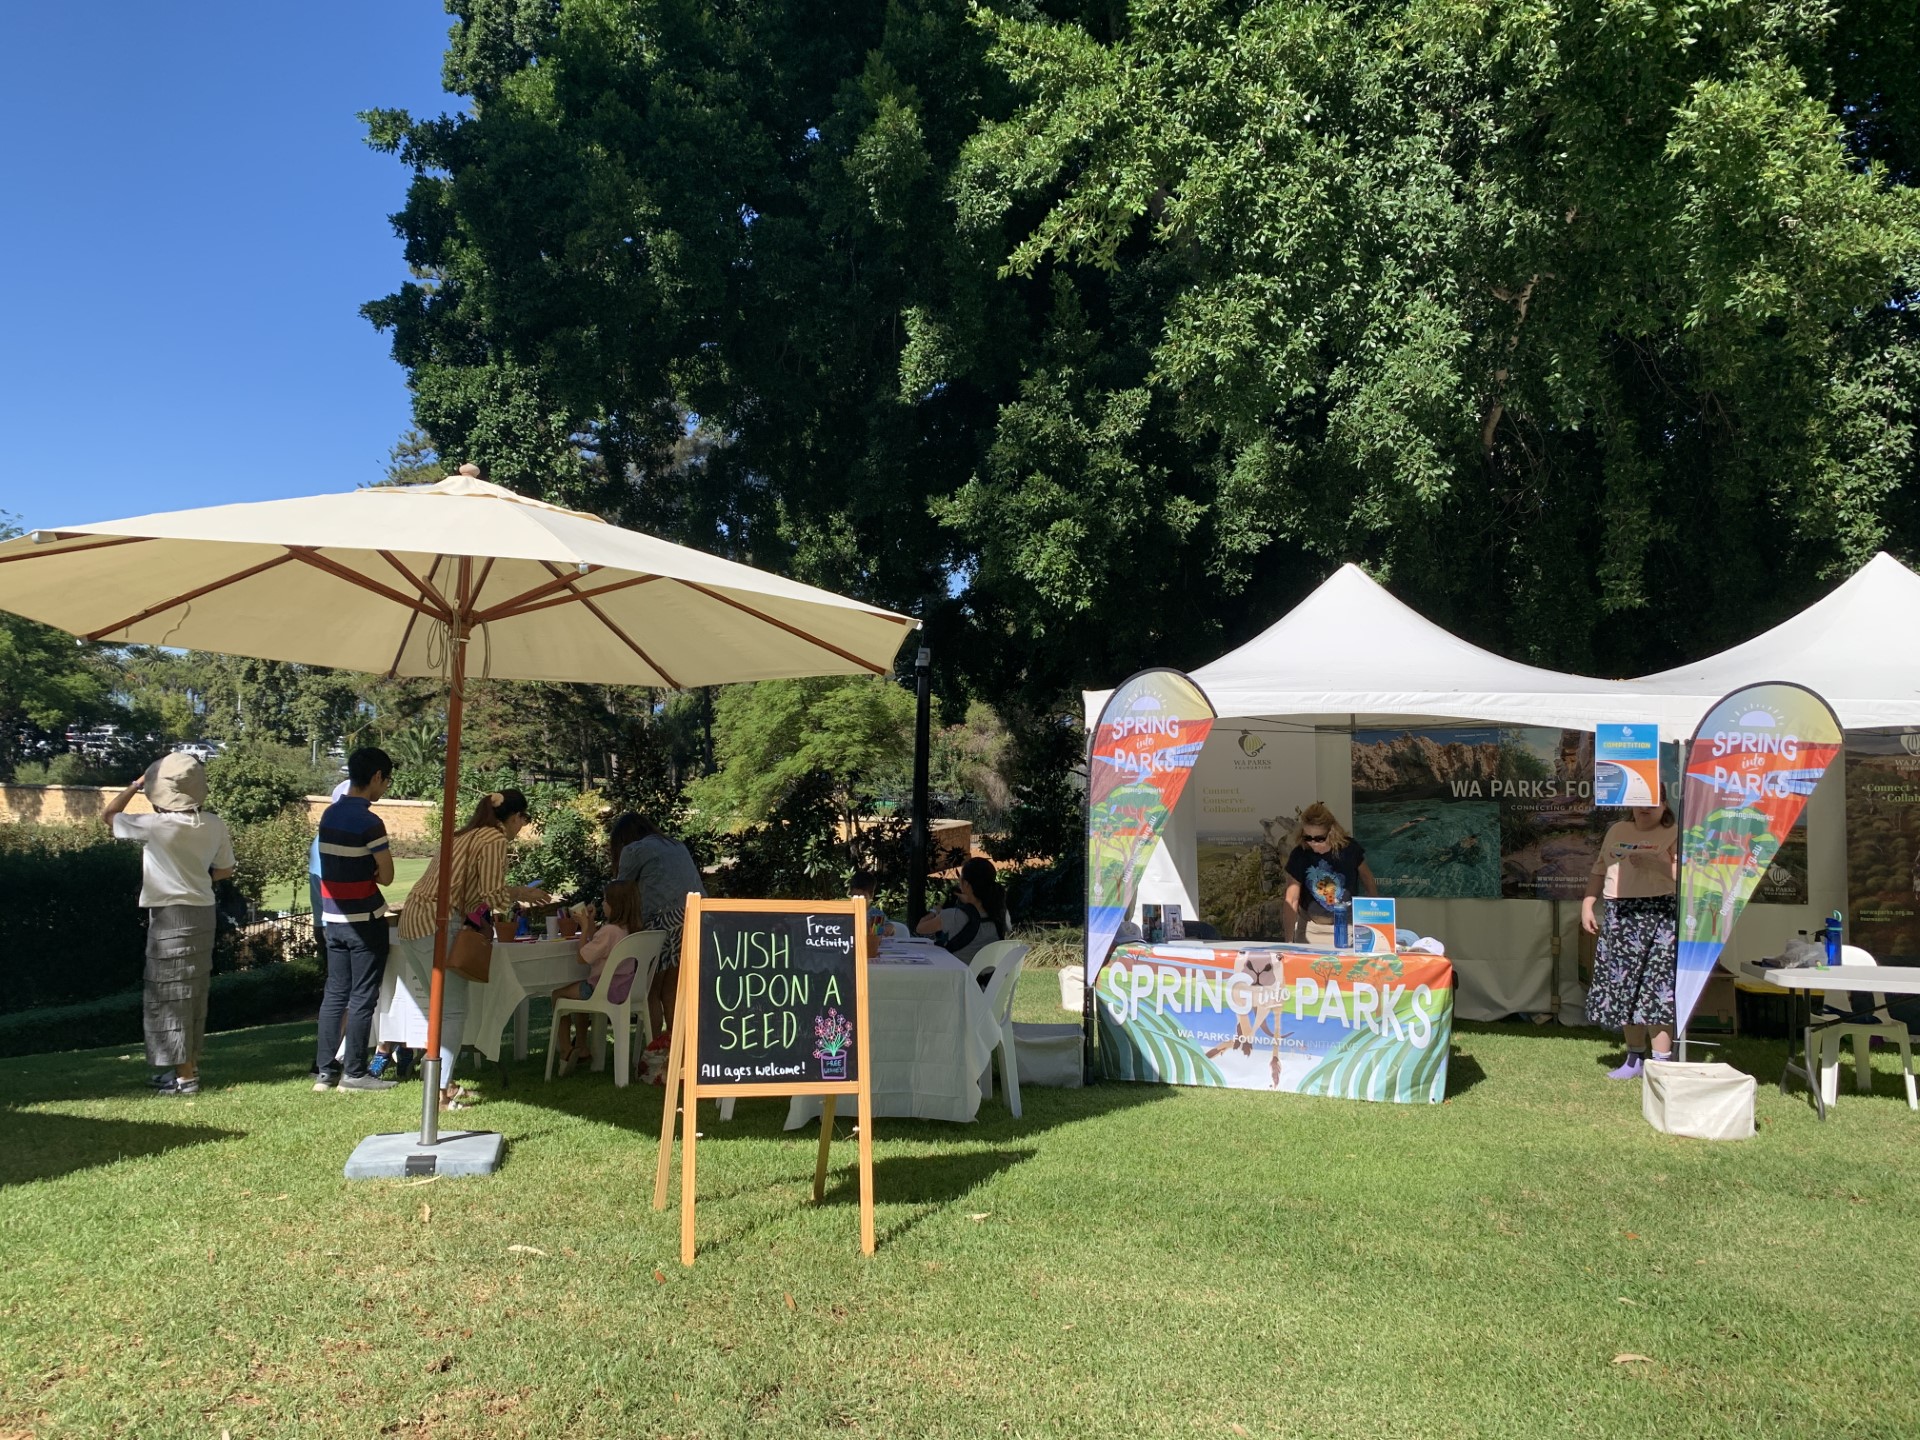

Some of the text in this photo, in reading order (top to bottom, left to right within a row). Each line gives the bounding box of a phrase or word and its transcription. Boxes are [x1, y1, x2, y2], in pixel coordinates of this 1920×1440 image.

[1112, 715, 1179, 740] SPRING
[1136, 734, 1155, 749] into
[1712, 731, 1799, 762] SPRING
[1114, 747, 1176, 773] PARKS
[1741, 753, 1766, 769] into
[1450, 780, 1483, 798] WA
[1491, 779, 1558, 798] PARKS
[1713, 765, 1791, 799] PARKS
[1866, 783, 1910, 792] Connect
[1203, 805, 1256, 813] Collaborate
[1510, 804, 1566, 812] CONNECTING
[805, 914, 842, 936] Free
[712, 930, 789, 971] WISH
[805, 936, 855, 955] activity!
[715, 972, 842, 1012] UPON A
[1107, 961, 1433, 1050] SPRING into PARKS
[719, 1011, 798, 1050] SEED
[1177, 1029, 1195, 1039] WA
[1197, 1031, 1230, 1042] PARKS
[1232, 1034, 1304, 1048] FOUNDATION
[701, 1061, 806, 1082] All ages welcome!
